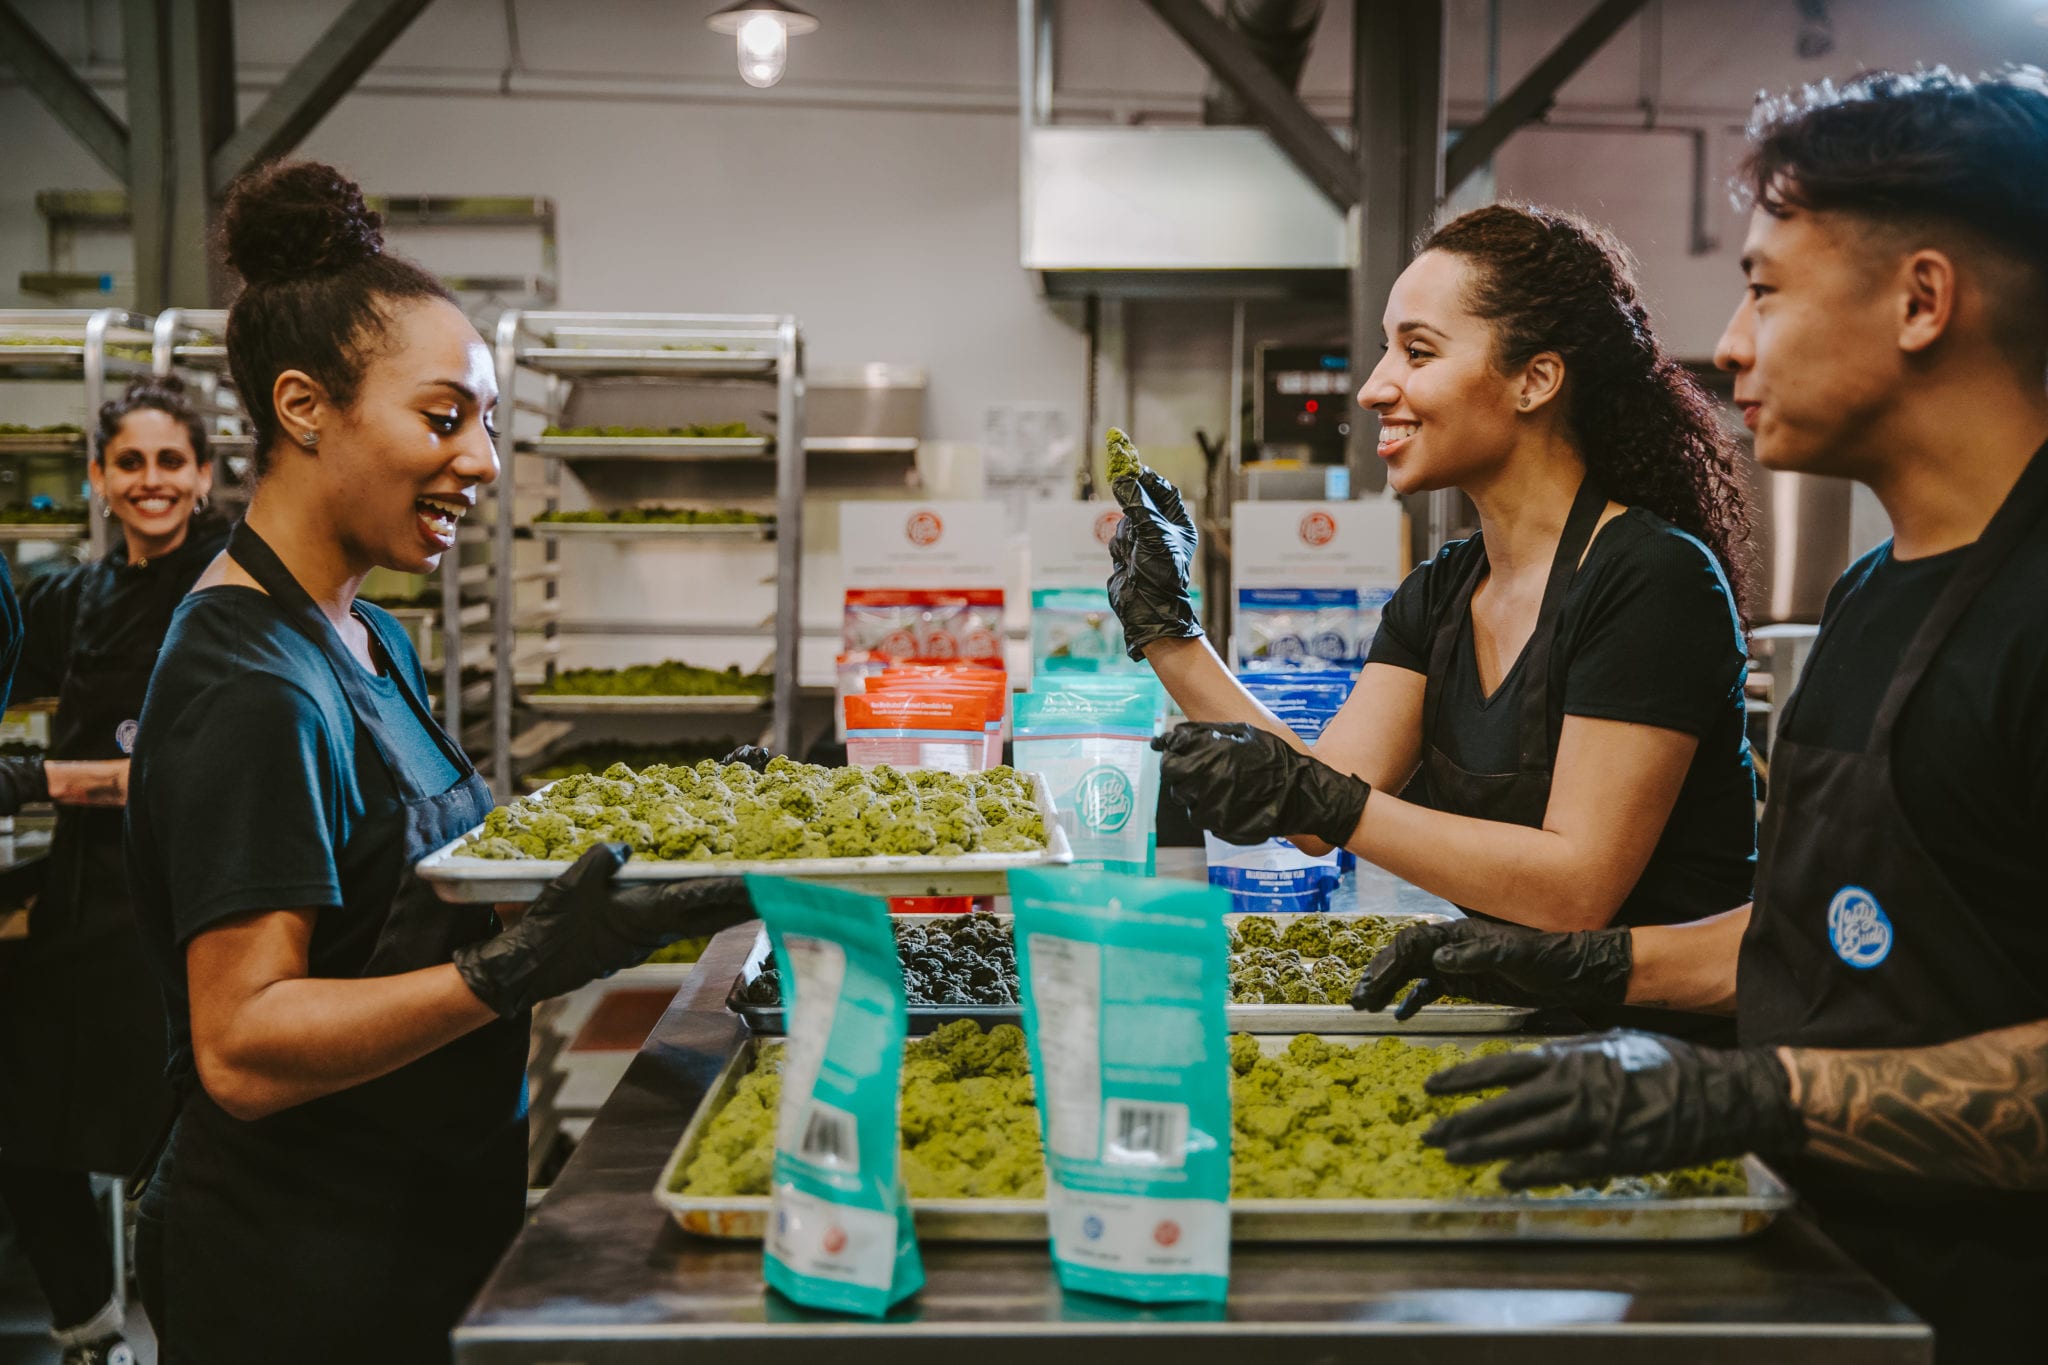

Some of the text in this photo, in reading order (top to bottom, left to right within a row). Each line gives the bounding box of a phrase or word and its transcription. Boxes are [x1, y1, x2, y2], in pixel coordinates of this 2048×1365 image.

[1076, 768, 1126, 816] Tasty
[1086, 796, 1130, 830] Buds
[1829, 888, 1877, 945] Tasty
[1839, 922, 1888, 964] Buds
